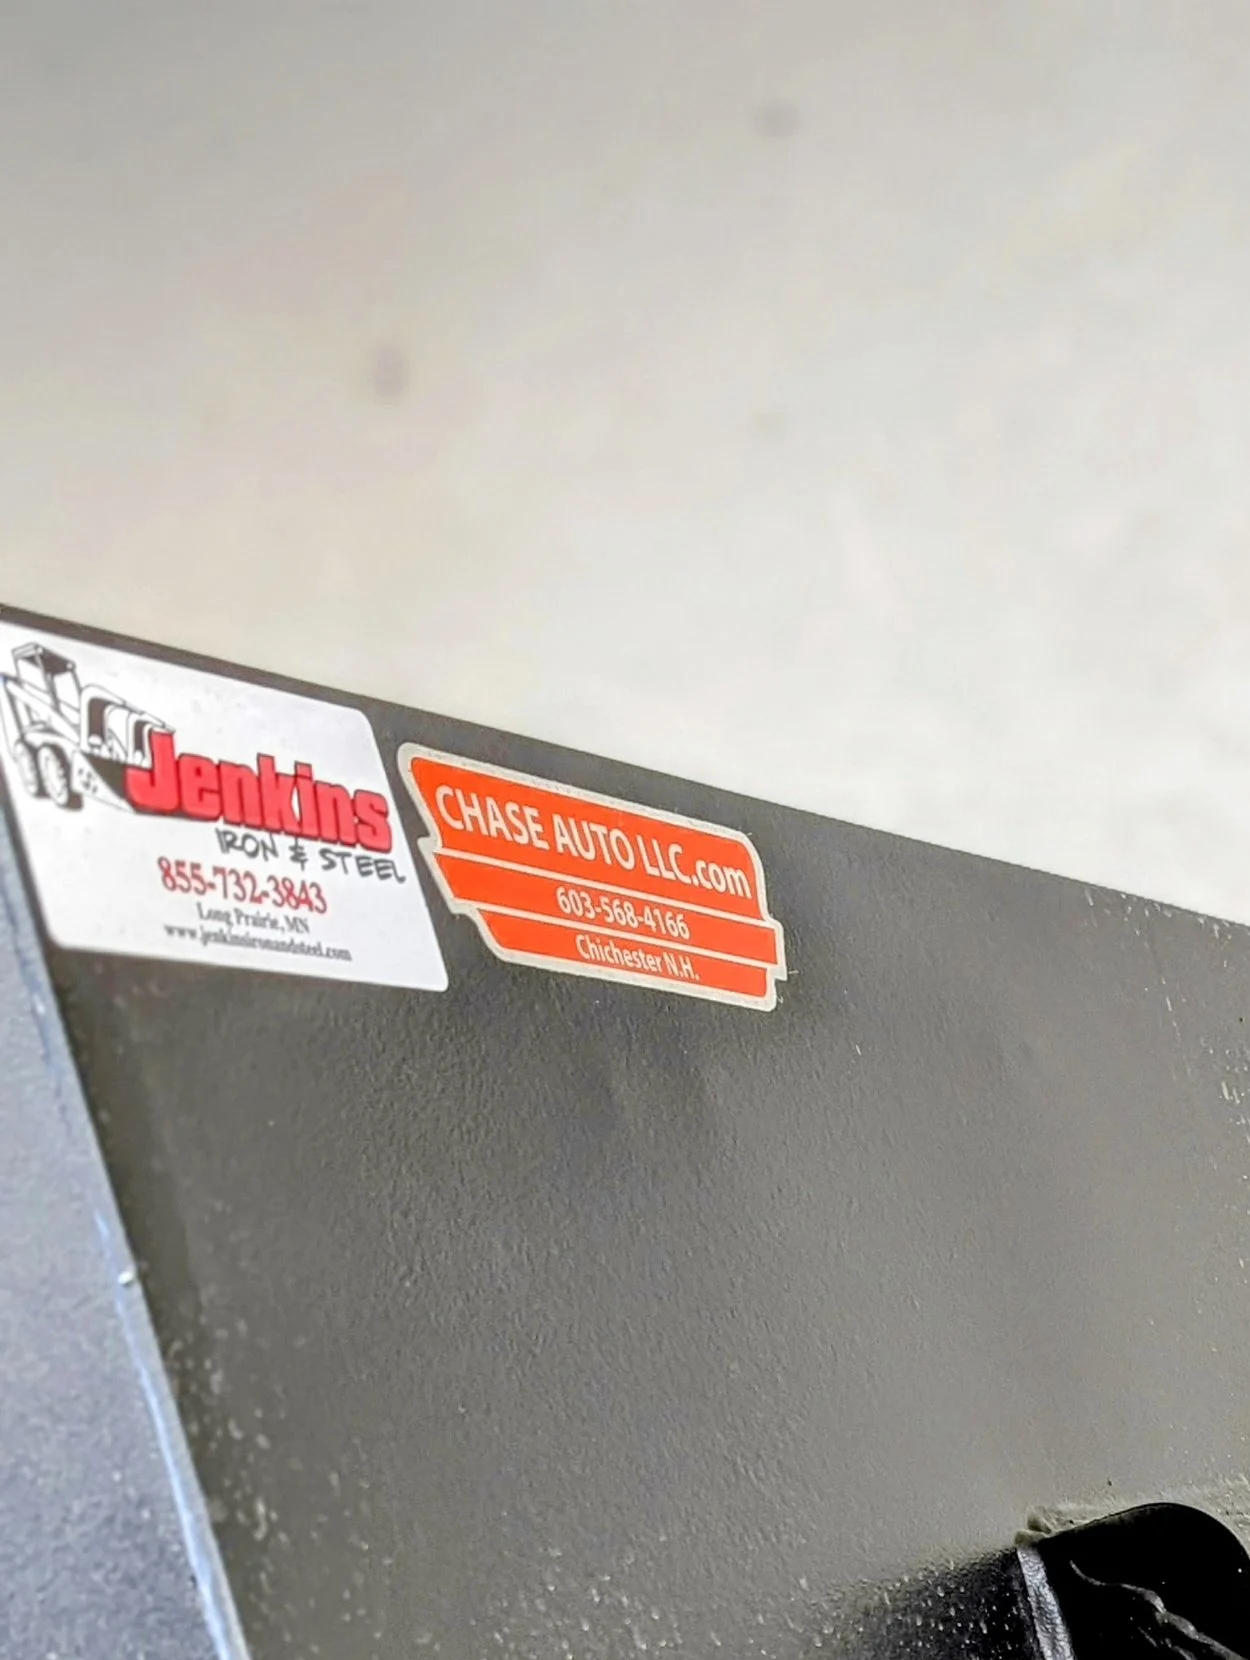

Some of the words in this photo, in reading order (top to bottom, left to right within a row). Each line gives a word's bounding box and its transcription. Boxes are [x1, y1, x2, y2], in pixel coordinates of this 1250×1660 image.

[125, 730, 392, 853] Jenkins
[215, 828, 279, 861] IRON
[319, 848, 406, 884] STEEL
[436, 785, 550, 850] CHASE
[554, 813, 635, 870] AUTO
[637, 838, 752, 899] LLC.com
[157, 856, 327, 914] 855-732-3843
[556, 886, 690, 940] 603-568-4166
[197, 901, 232, 927] Long
[576, 934, 662, 972] Chichester
